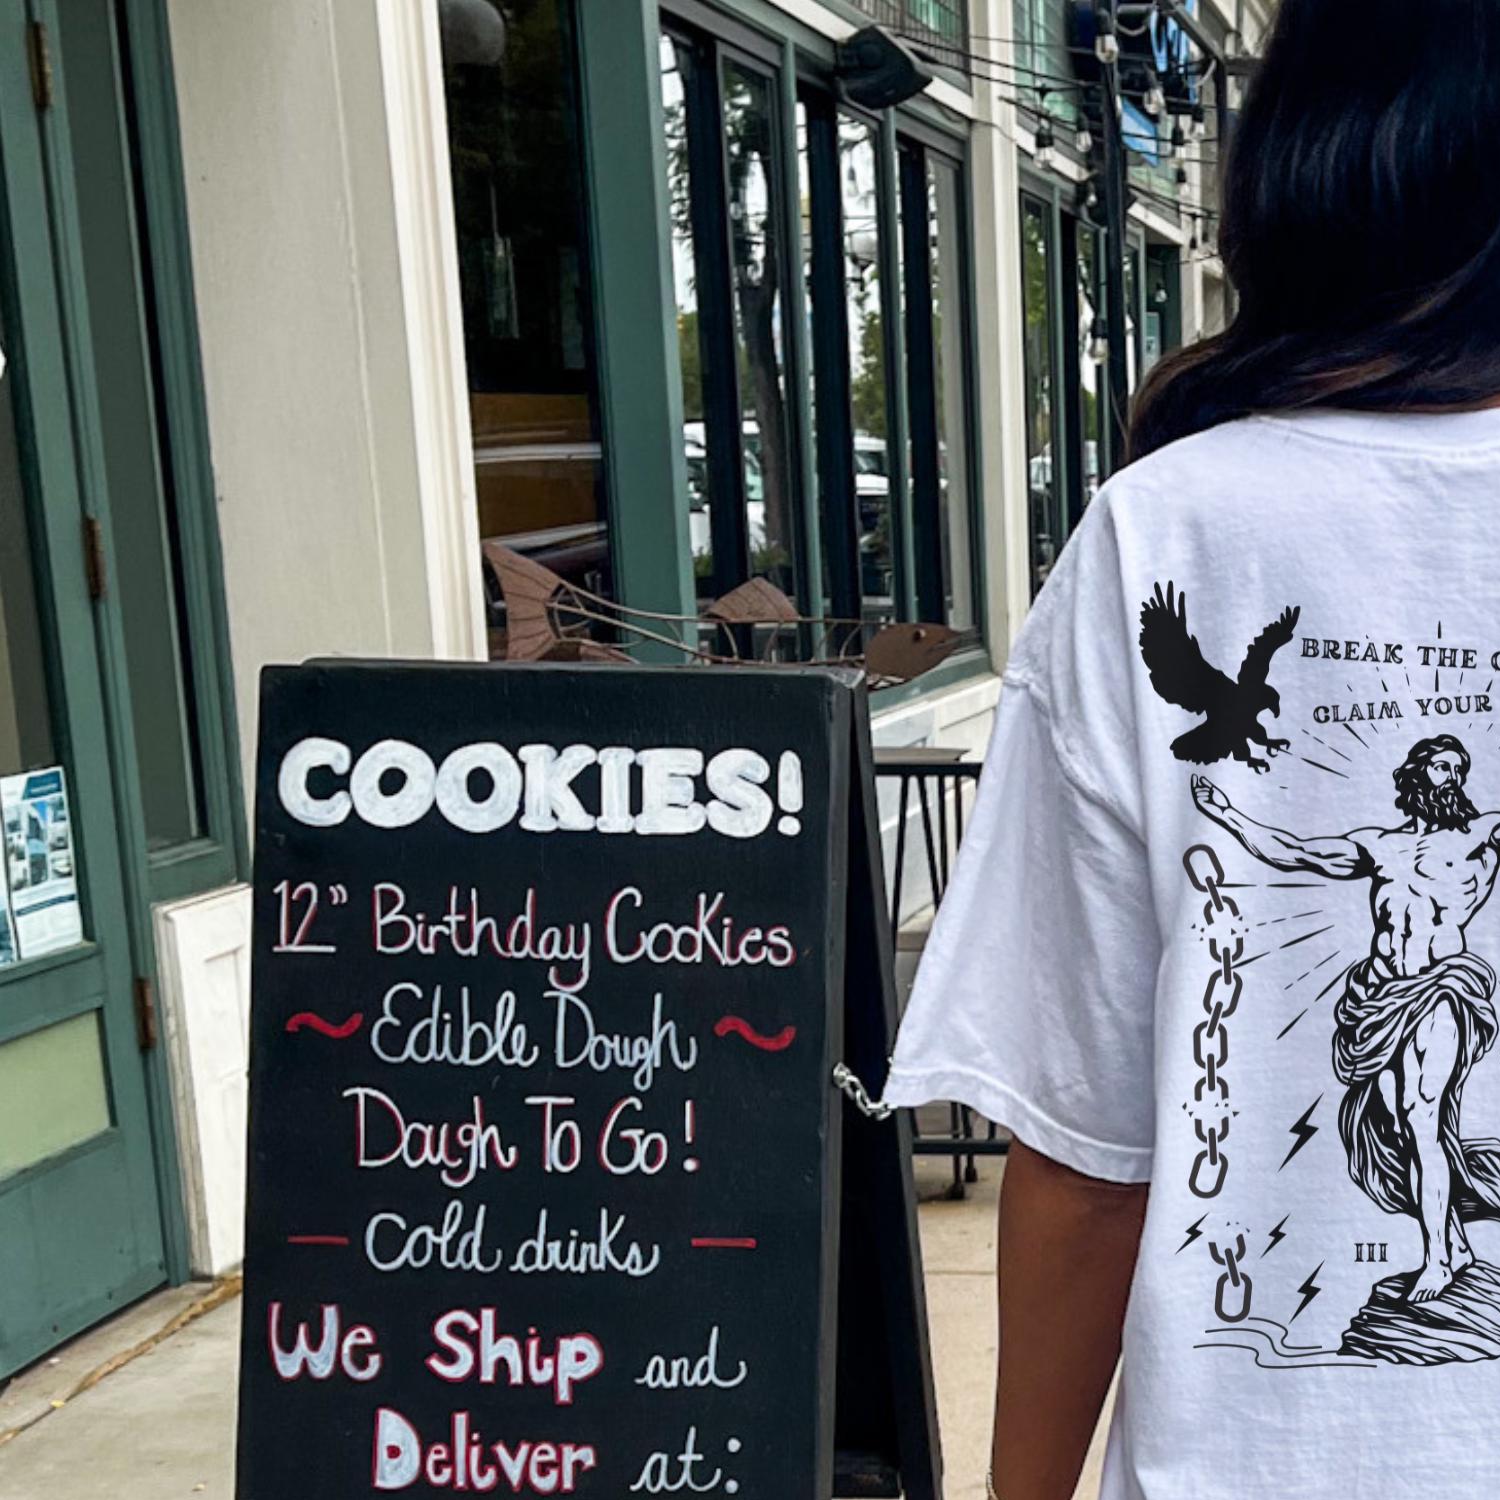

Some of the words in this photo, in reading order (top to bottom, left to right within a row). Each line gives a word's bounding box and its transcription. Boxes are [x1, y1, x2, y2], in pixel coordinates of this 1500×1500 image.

[1301, 638, 1402, 663] BREAK
[1418, 646, 1476, 668] THE
[1314, 702, 1403, 723] CLAIM
[1416, 695, 1492, 715] YOUR
[279, 737, 803, 838] COOKIES!
[373, 882, 592, 992] Birthday
[370, 982, 539, 1068] Edible
[543, 992, 698, 1091] Dough
[342, 1086, 518, 1187] Dough
[524, 1096, 580, 1173] To
[364, 1199, 503, 1273] Cold
[1356, 1244, 1387, 1262] III
[269, 1302, 382, 1380] We
[425, 1307, 604, 1404] Ship
[634, 1326, 748, 1389] and
[373, 1407, 597, 1492] Deliver
[629, 1426, 743, 1494] at:
